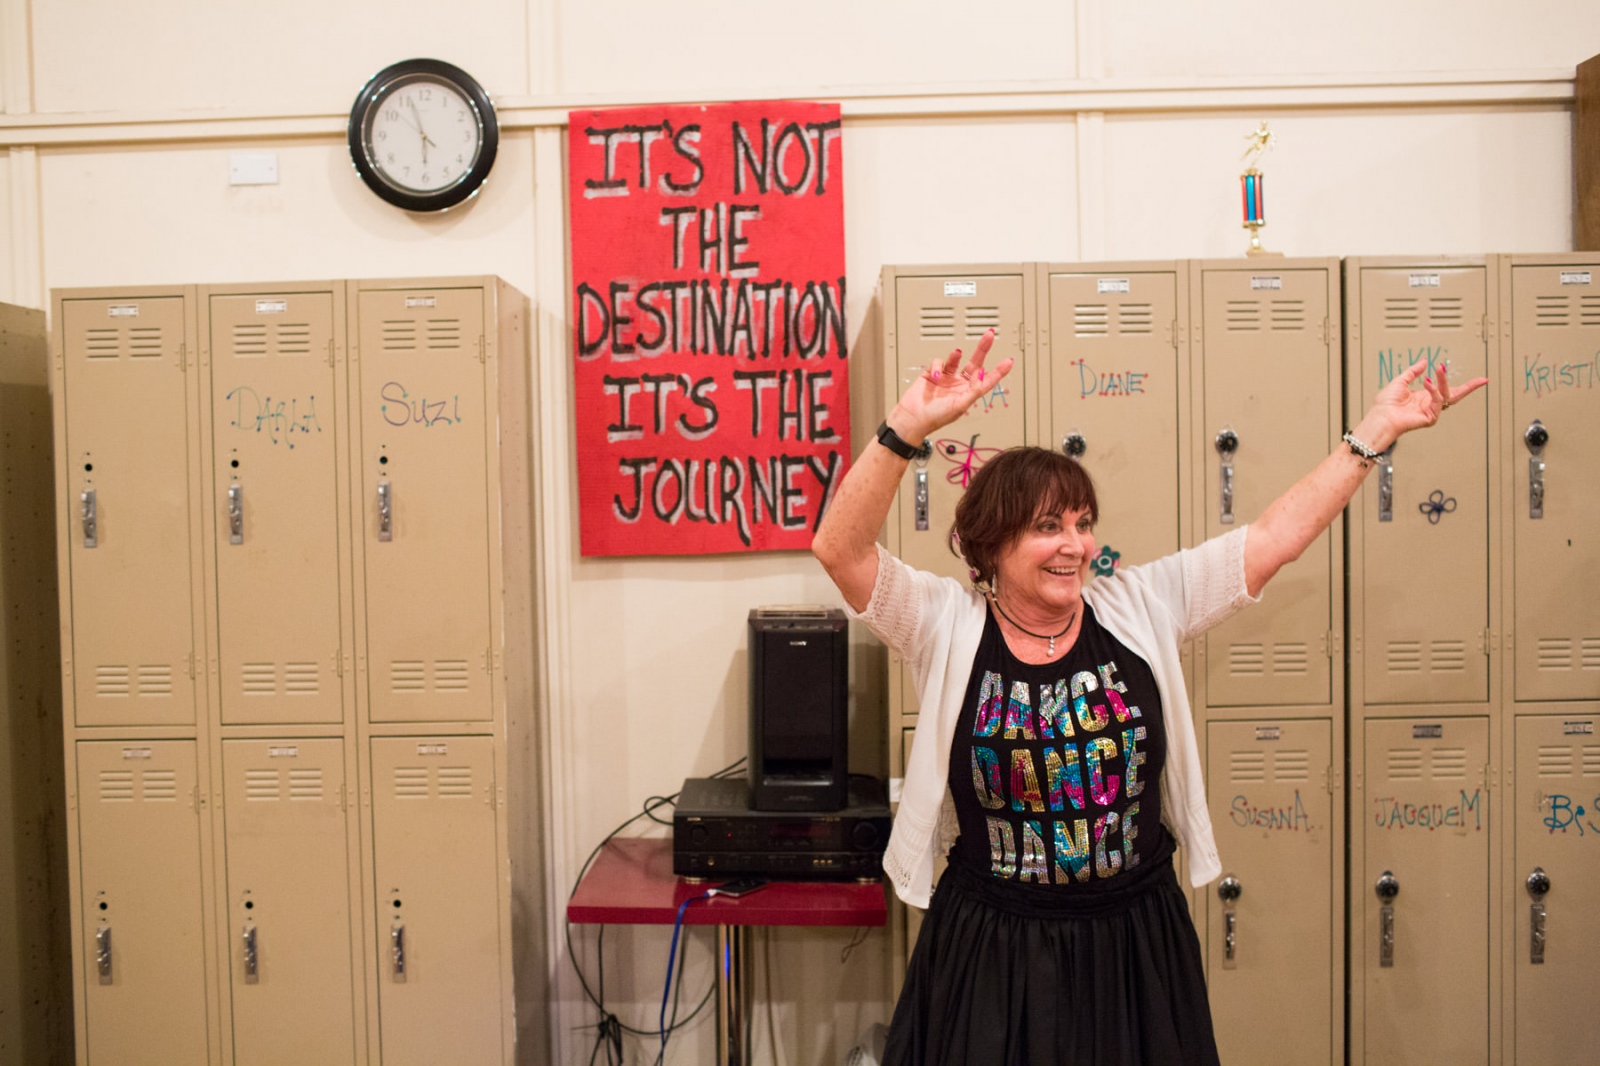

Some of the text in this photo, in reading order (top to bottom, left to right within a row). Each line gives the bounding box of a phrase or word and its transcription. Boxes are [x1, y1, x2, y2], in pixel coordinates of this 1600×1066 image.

[384, 110, 399, 122] 10
[418, 89, 432, 101] 12
[457, 110, 465, 122] 2
[378, 131, 387, 142] 9
[455, 153, 463, 164] 4
[584, 118, 842, 199] IT'S NOT
[659, 202, 762, 279] THE
[577, 276, 847, 361] DESTINATION
[603, 368, 842, 444] IT'S THE
[1070, 358, 1148, 399] DIANE
[612, 450, 842, 547] JOURNEY
[973, 661, 1142, 740] DANCE
[971, 726, 1147, 812] DANCE
[986, 801, 1141, 884] DANCE
